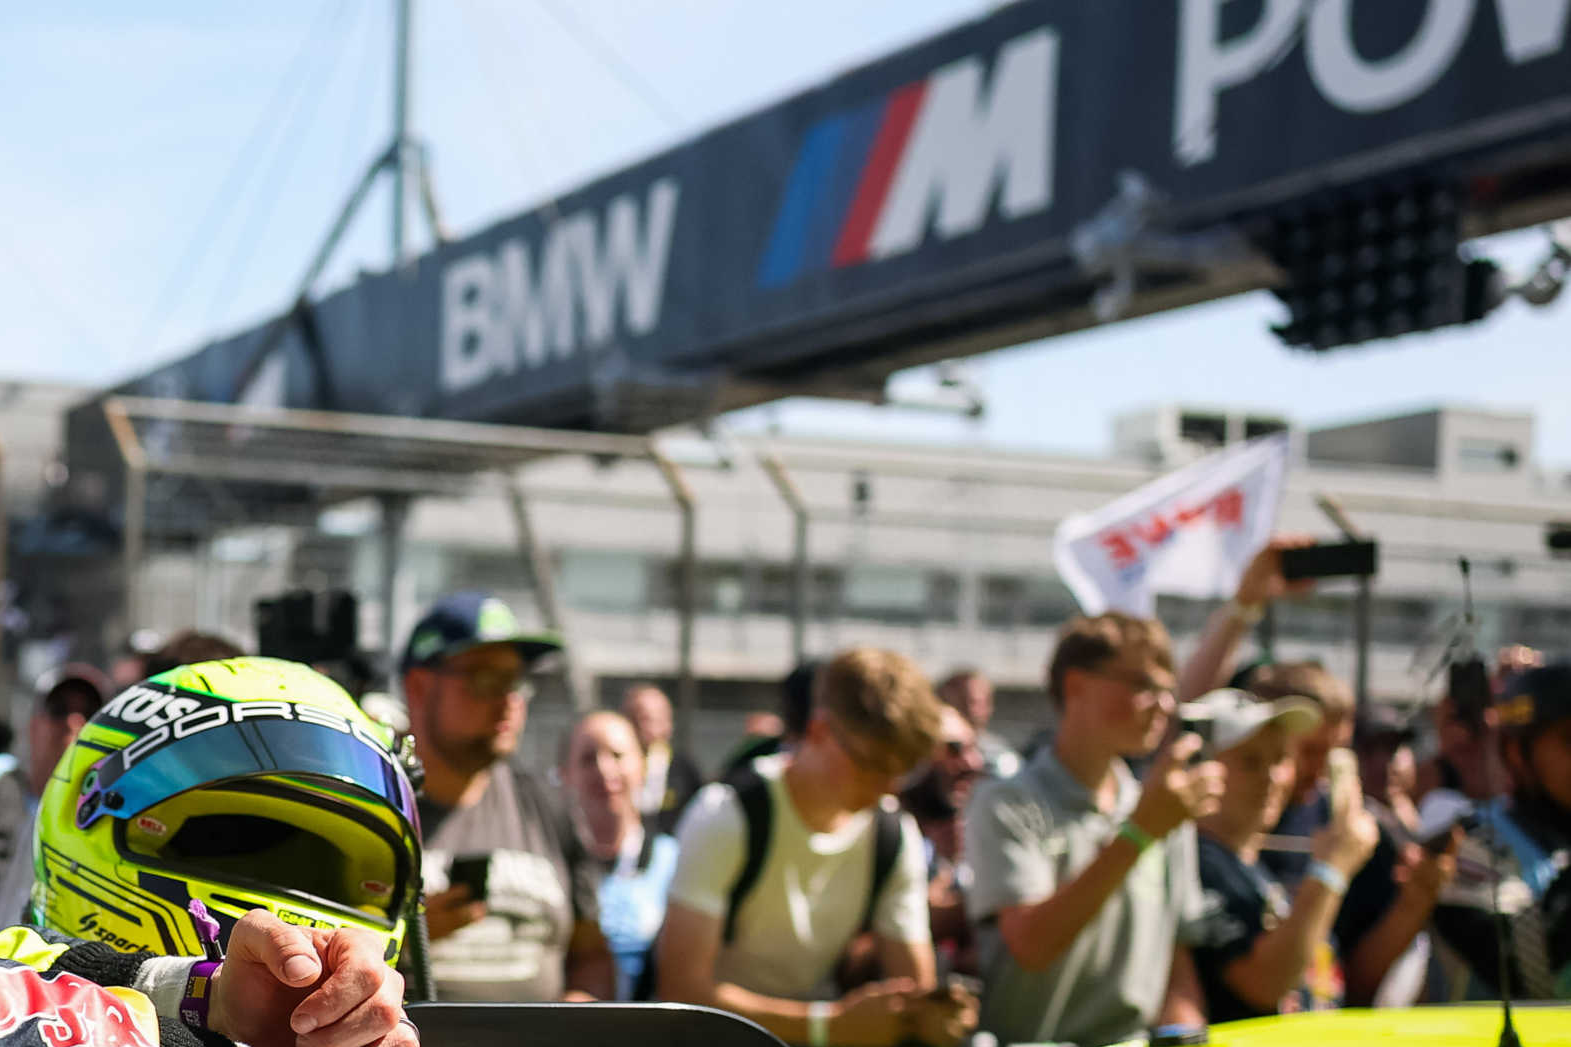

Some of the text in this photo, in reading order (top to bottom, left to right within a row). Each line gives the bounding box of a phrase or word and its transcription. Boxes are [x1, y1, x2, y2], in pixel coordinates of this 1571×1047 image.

[1173, 0, 1571, 168] PO
[440, 176, 679, 392] BMW
[122, 701, 395, 770] PORSC
[94, 925, 152, 952] spar
